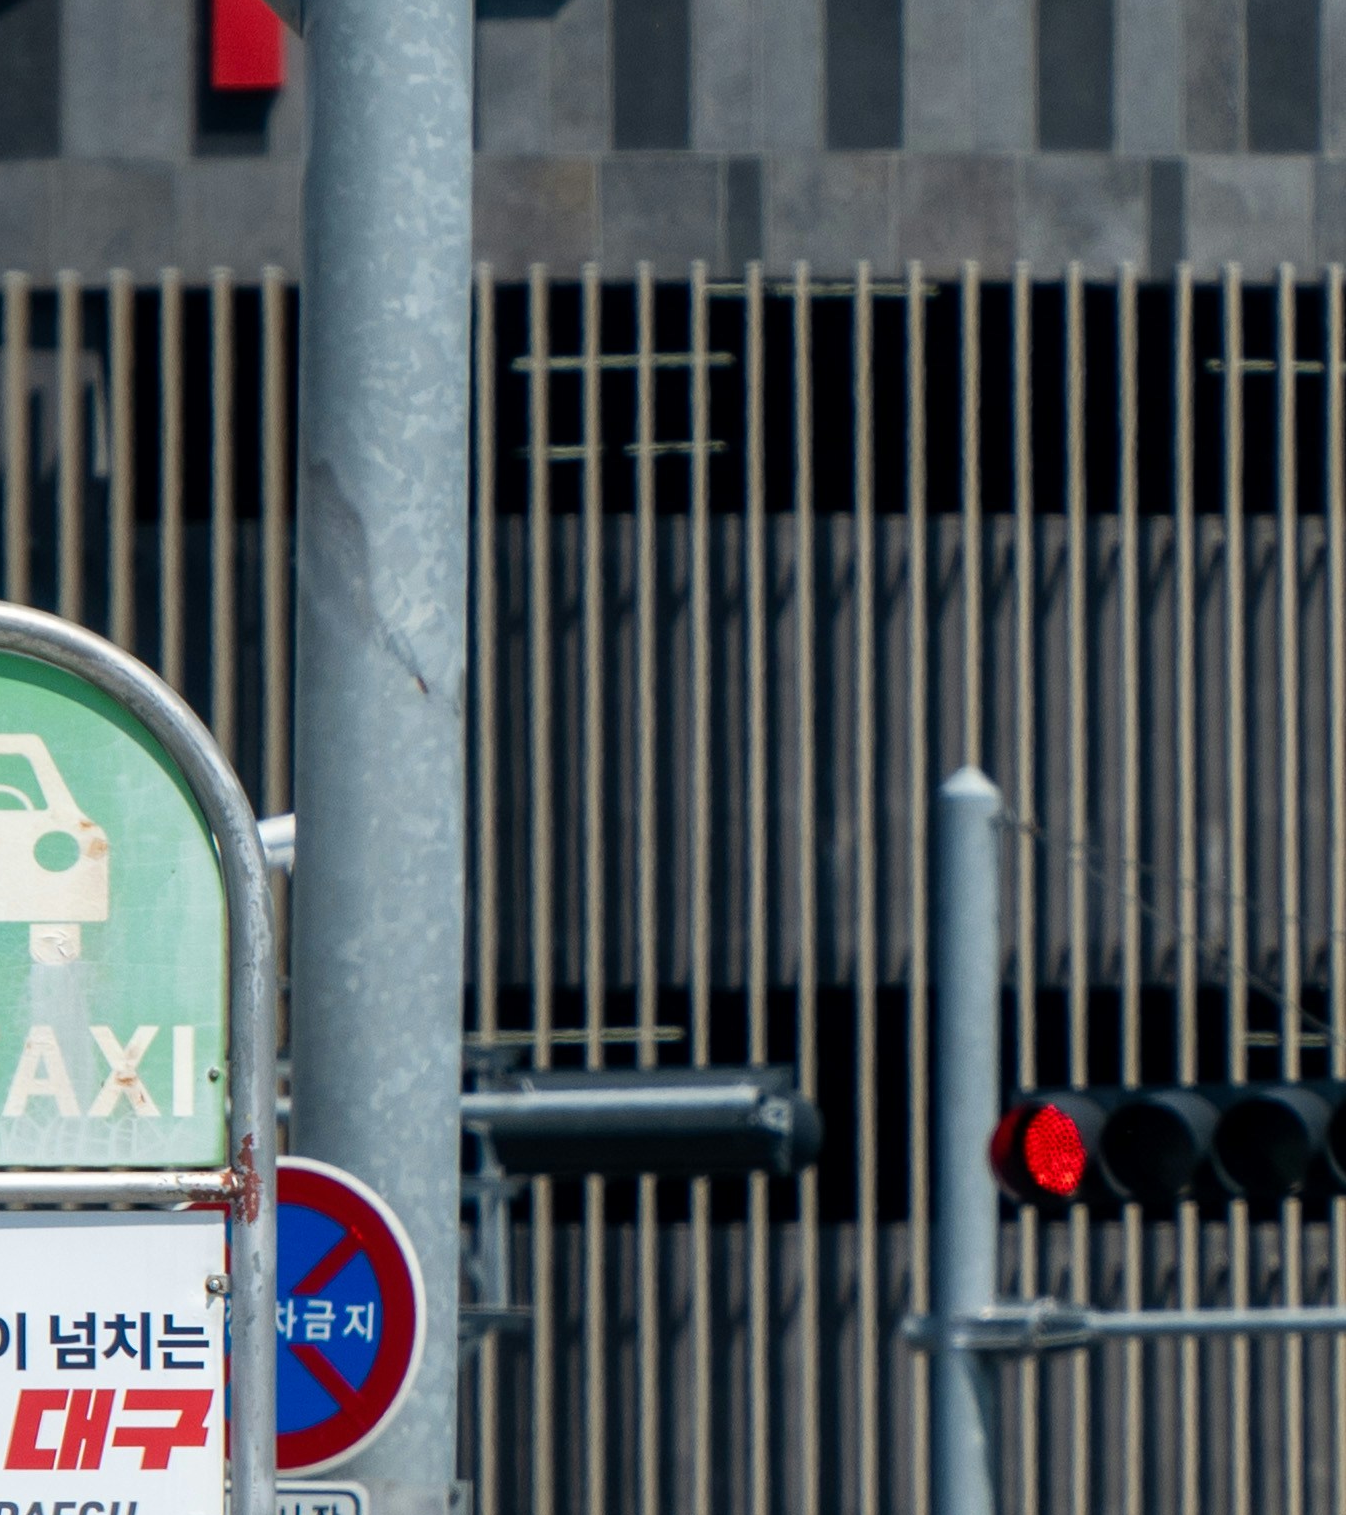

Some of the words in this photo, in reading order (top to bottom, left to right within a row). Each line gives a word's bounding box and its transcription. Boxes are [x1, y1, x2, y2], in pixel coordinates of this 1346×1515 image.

[49, 1312, 211, 1370] 넘치는
[225, 1298, 375, 1343] 차금지
[3, 1388, 214, 1471] 대구
